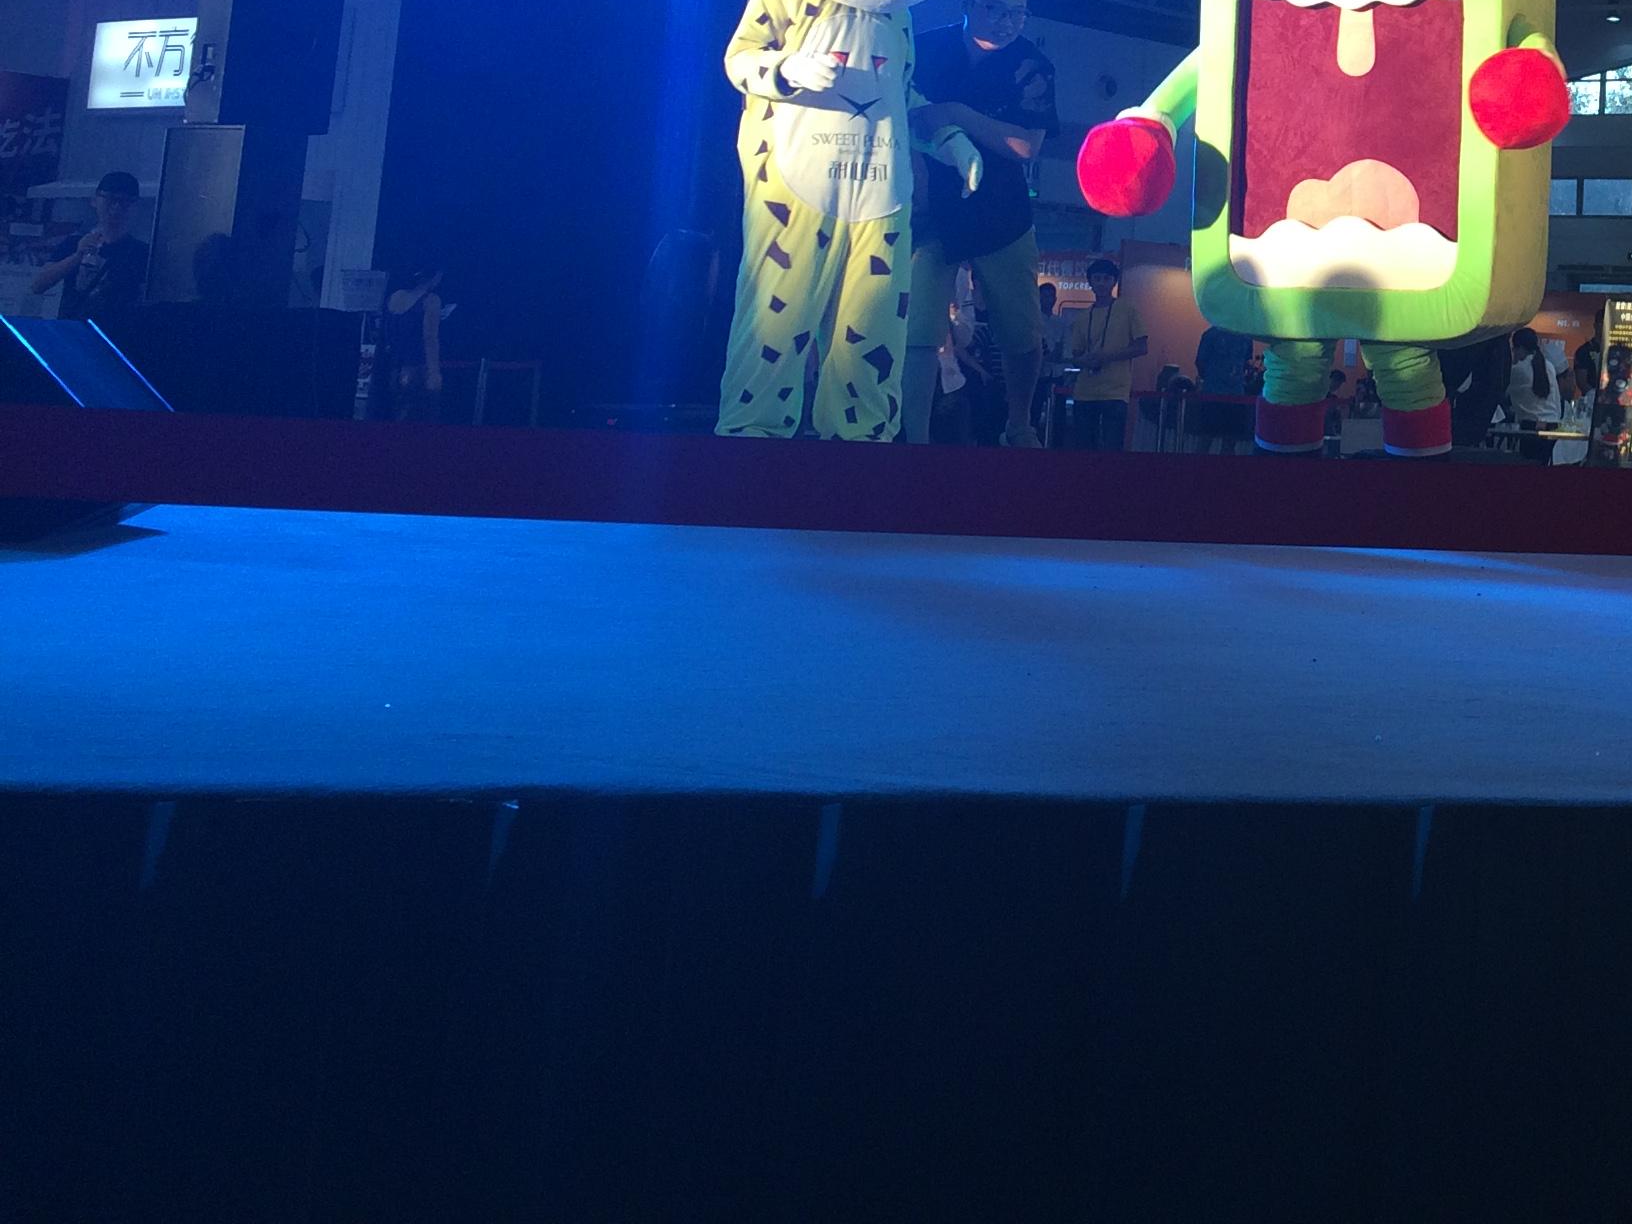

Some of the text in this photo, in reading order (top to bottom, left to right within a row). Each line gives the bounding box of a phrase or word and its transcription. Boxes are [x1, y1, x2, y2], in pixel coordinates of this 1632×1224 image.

[123, 27, 196, 77] 不方
[811, 133, 901, 150] SWEET PUMA
